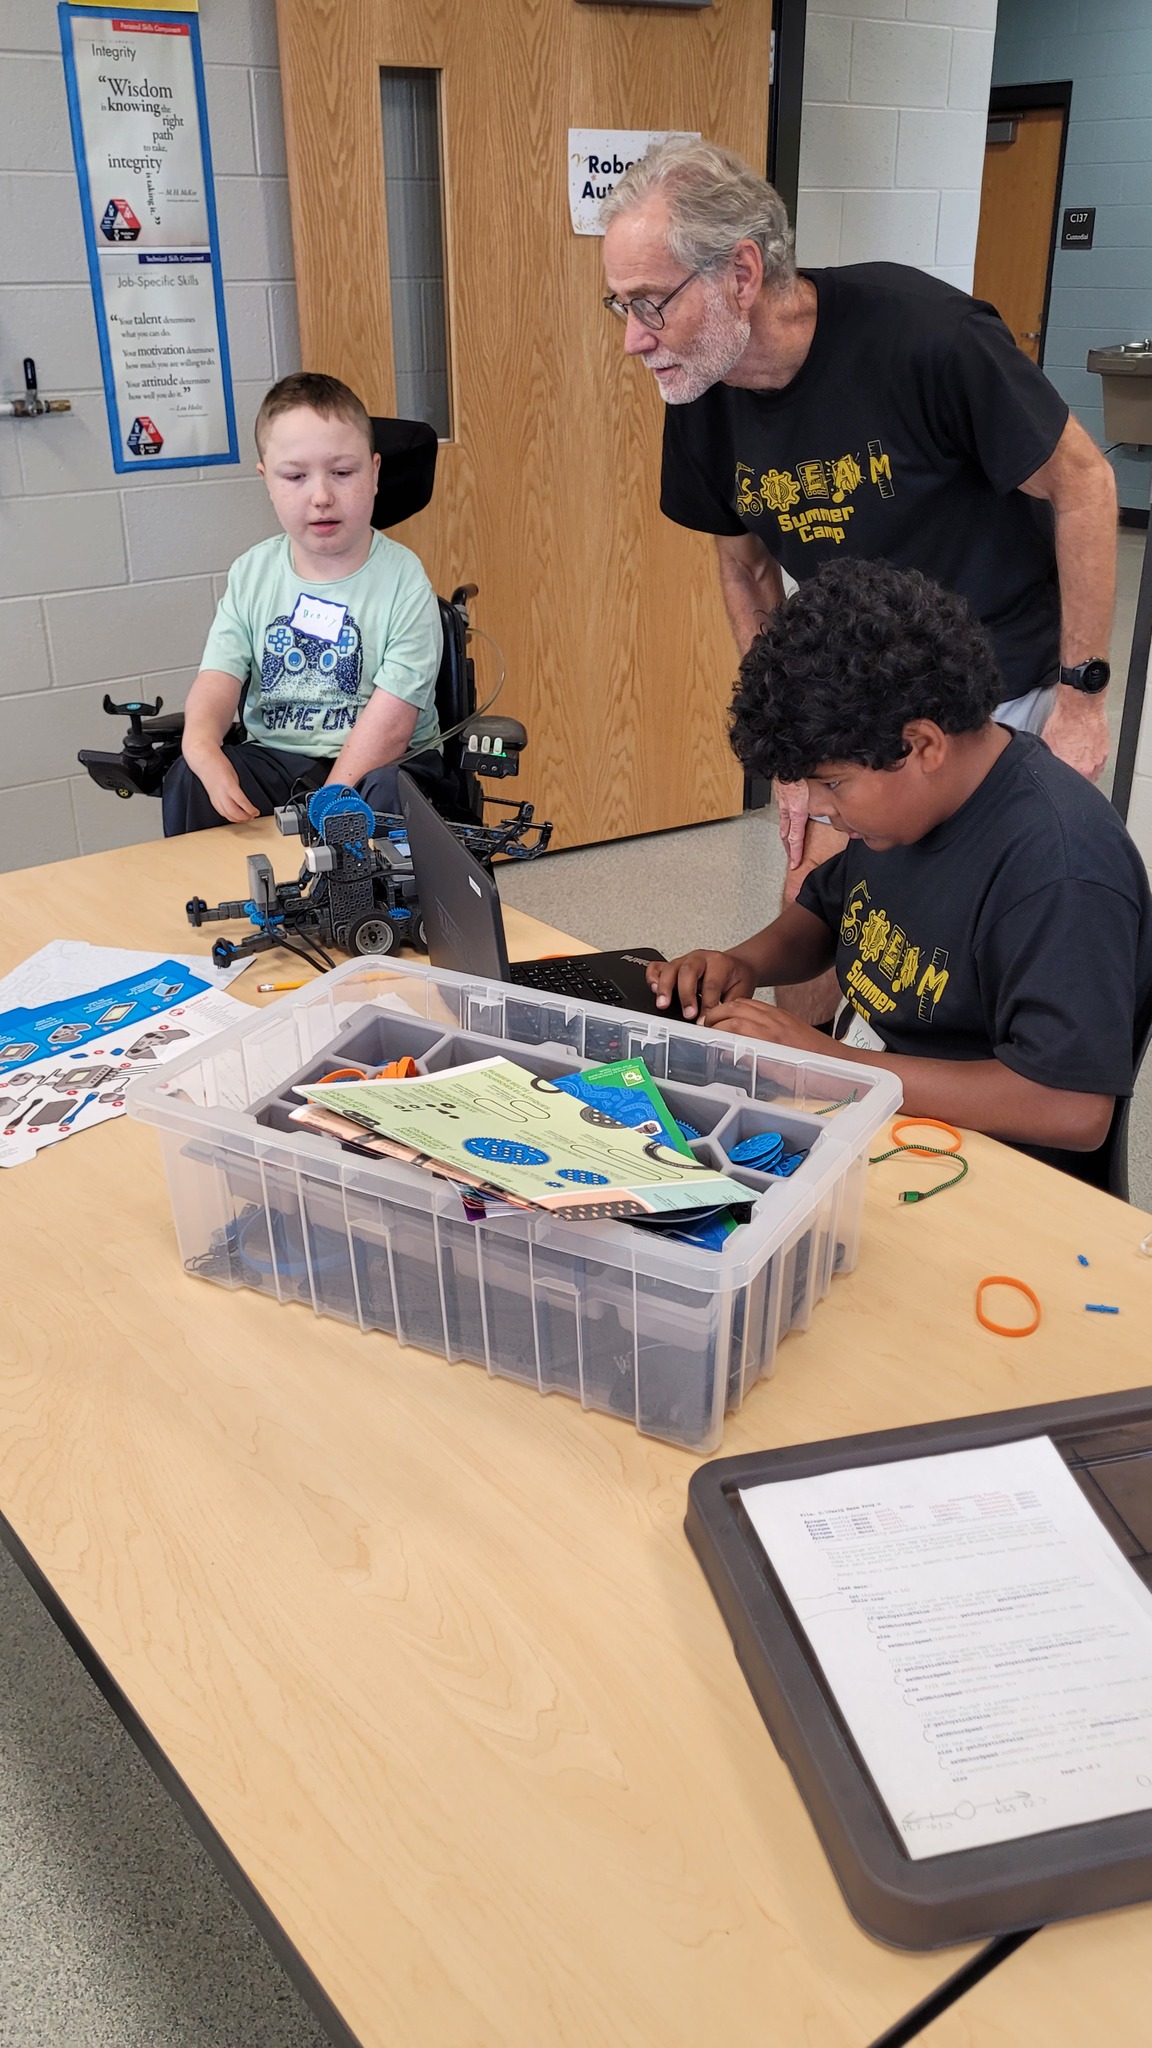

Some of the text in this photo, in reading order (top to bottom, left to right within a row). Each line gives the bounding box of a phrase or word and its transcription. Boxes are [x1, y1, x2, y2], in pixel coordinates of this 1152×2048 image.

[91, 43, 136, 62] Integrity
[107, 97, 161, 117] knowing
[161, 104, 171, 113] the
[162, 114, 184, 130] right
[152, 128, 174, 144] path
[108, 153, 162, 174] integrity
[147, 180, 155, 206] taking
[1070, 213, 1089, 223] C137
[117, 274, 199, 290] Job-Specific Skills
[134, 312, 162, 325] talent
[121, 330, 136, 338] what
[137, 332, 148, 340] you
[137, 344, 185, 357] motivation
[125, 361, 139, 370] how
[140, 360, 157, 368] much
[157, 361, 168, 370] you
[141, 374, 178, 388] attitude
[128, 392, 141, 400] how
[143, 391, 155, 399] well
[156, 393, 167, 401] you
[168, 390, 176, 398] do
[738, 448, 894, 508] STEAM
[777, 505, 855, 533] Summer
[799, 525, 846, 545] Camp
[262, 704, 358, 731] GAME ON
[846, 959, 897, 1014] Summer
